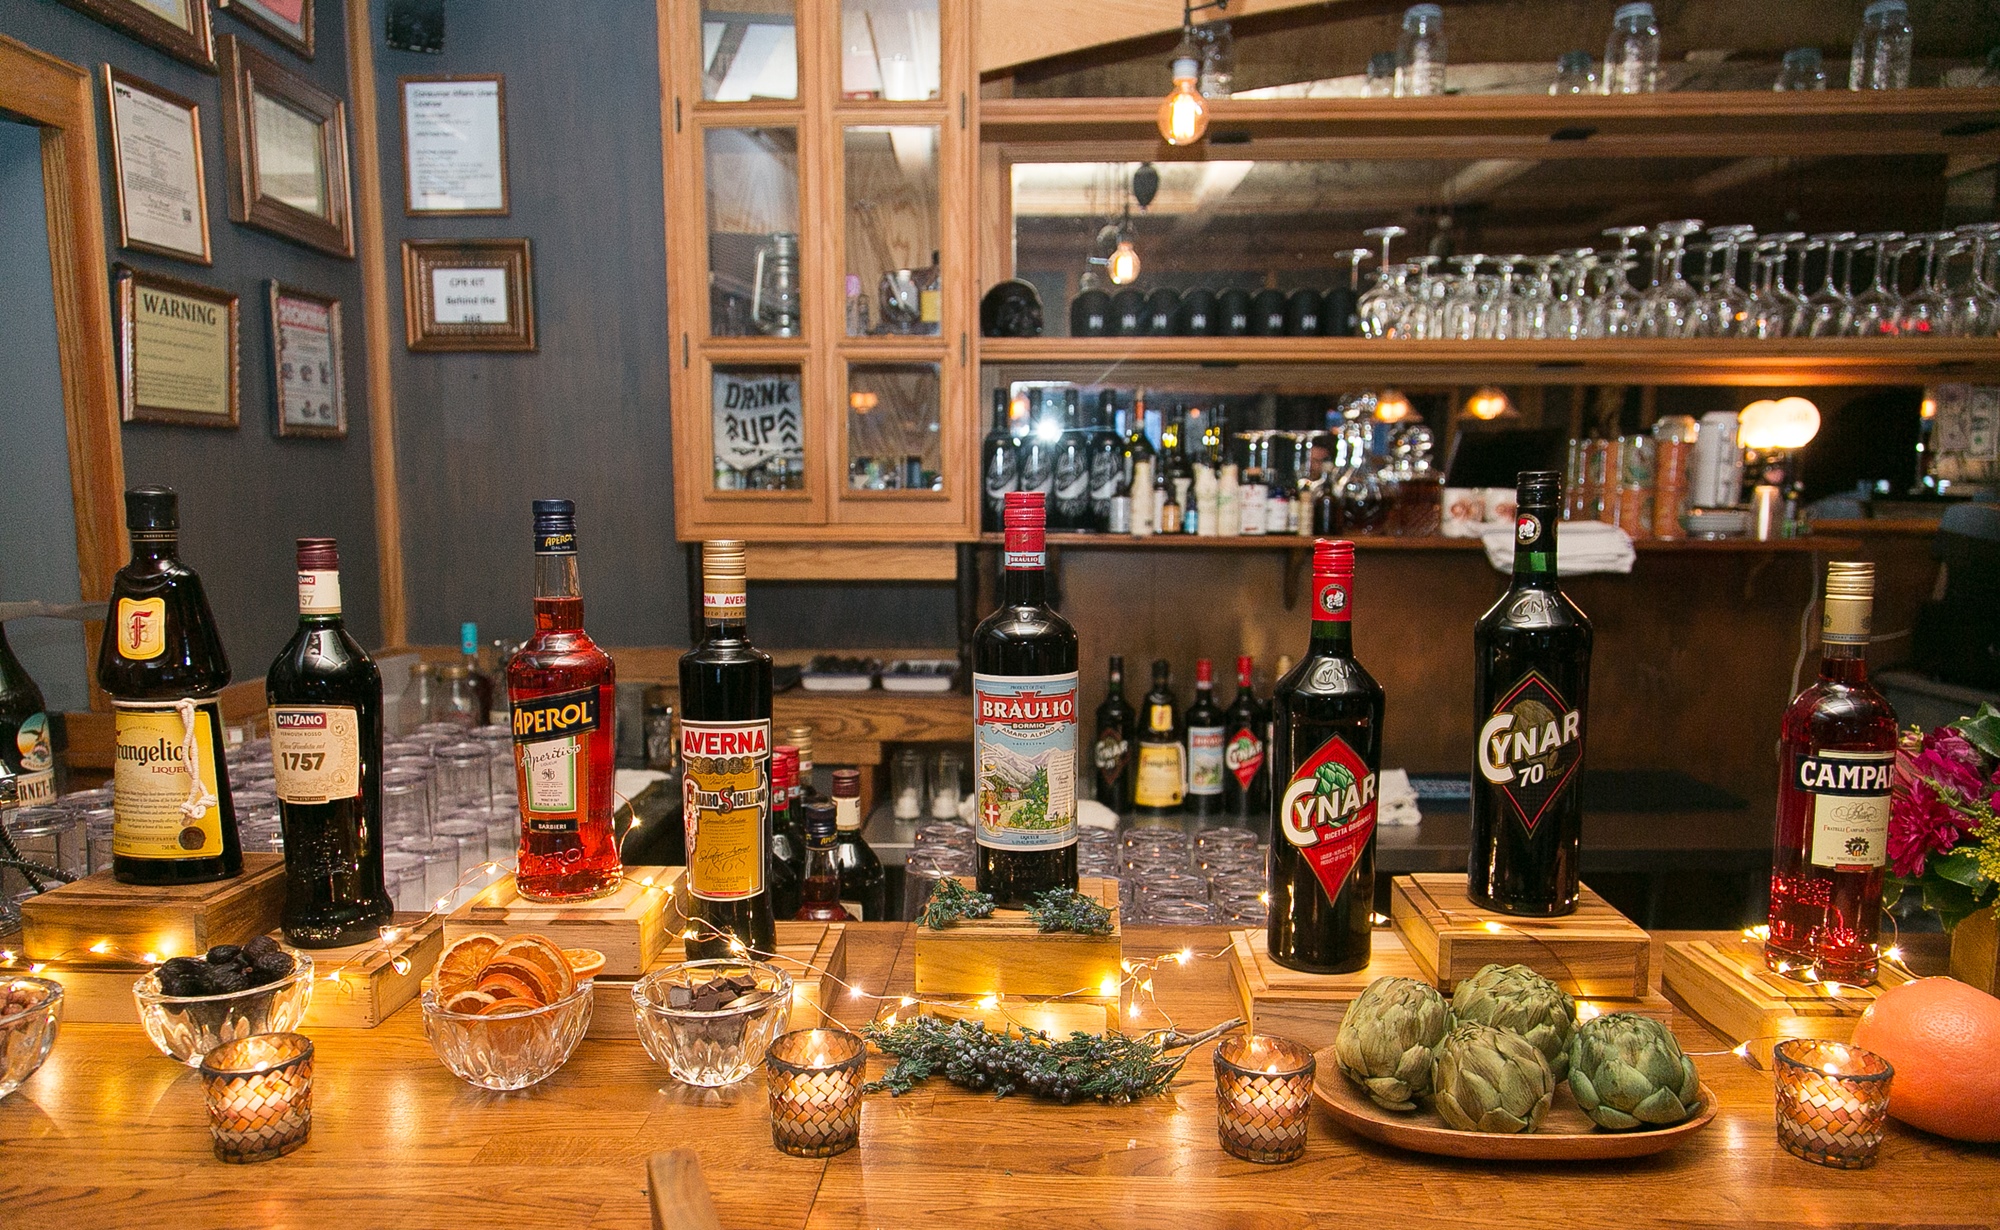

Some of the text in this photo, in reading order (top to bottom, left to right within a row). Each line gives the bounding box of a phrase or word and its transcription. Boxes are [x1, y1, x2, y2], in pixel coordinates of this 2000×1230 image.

[143, 292, 217, 327] WARNING
[724, 382, 789, 410] DRINK
[741, 415, 775, 445] UP
[545, 534, 573, 548] APEROL
[278, 714, 323, 726] CINZANO
[514, 701, 592, 736] APEROL
[684, 730, 766, 756] AVERNA
[1001, 726, 1056, 739] AMARO ALPINO
[521, 744, 581, 771] Aperitivo
[1480, 709, 1580, 783] CYNAR
[281, 752, 326, 772] 1757
[1518, 763, 1544, 787] 70
[1282, 773, 1376, 847] CYNAR
[1324, 828, 1348, 841] RICETTA
